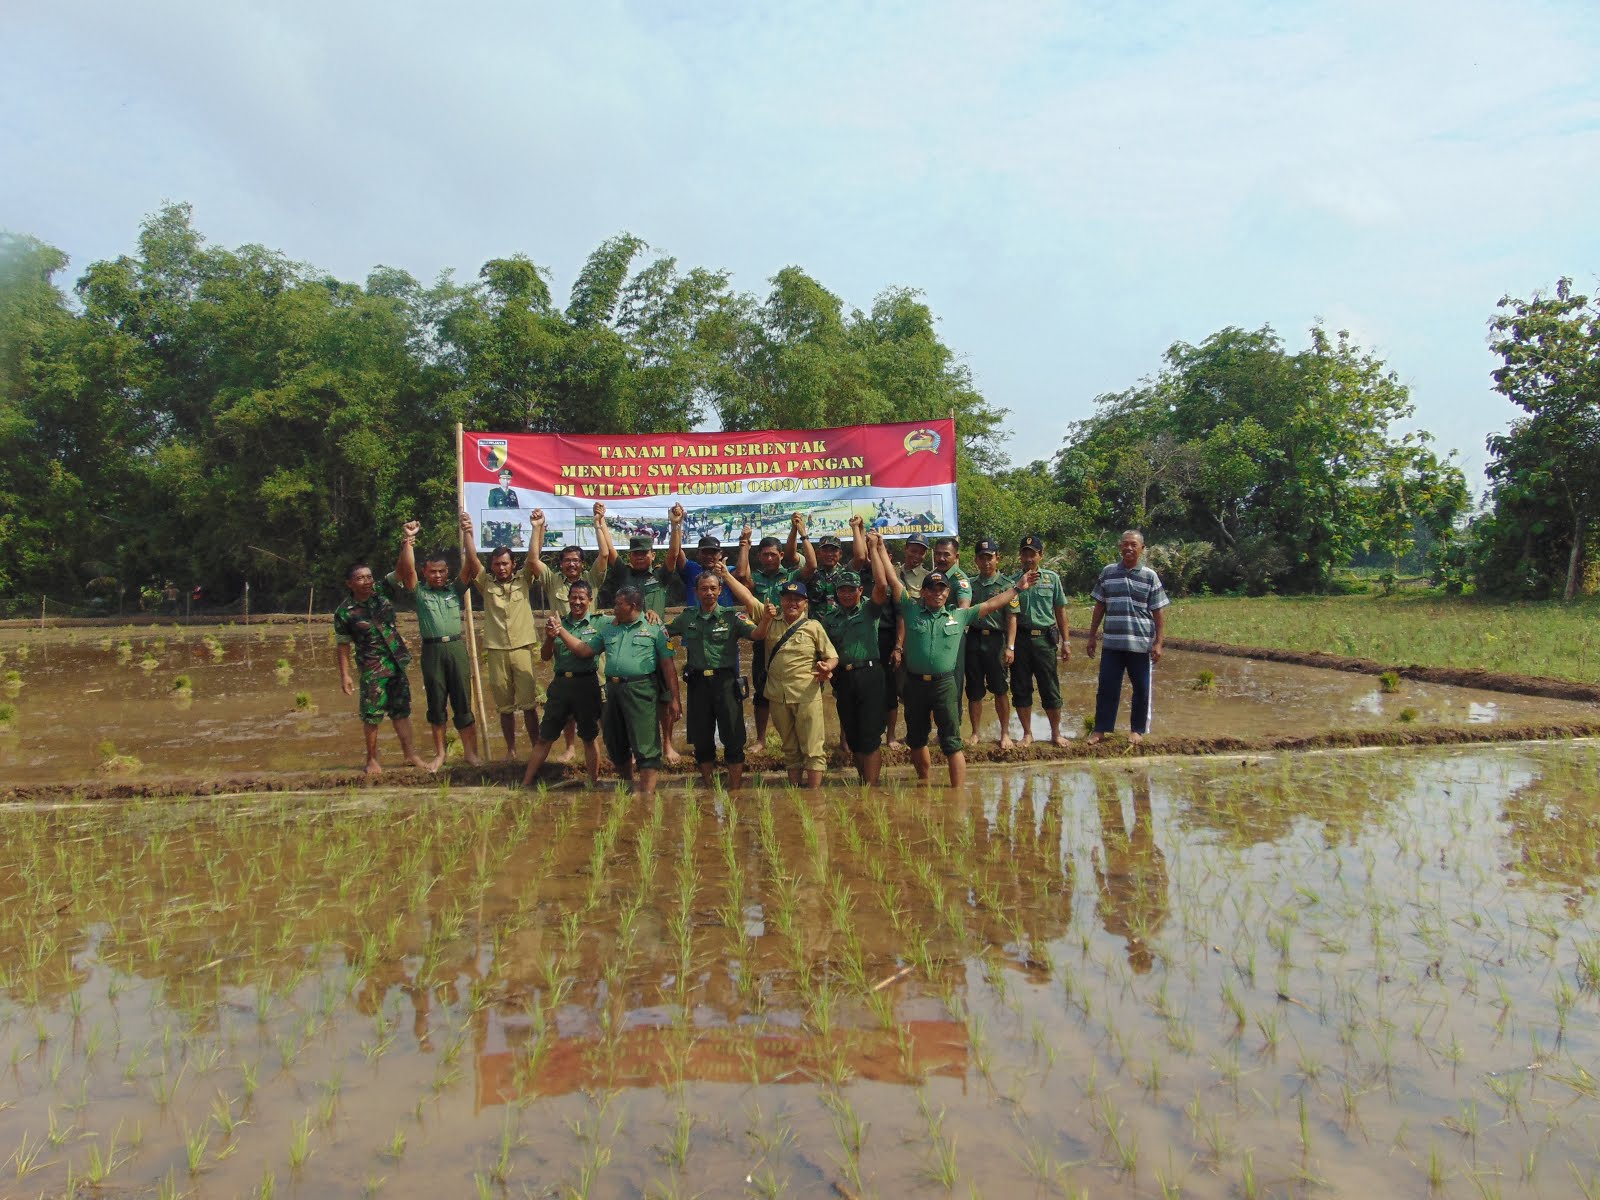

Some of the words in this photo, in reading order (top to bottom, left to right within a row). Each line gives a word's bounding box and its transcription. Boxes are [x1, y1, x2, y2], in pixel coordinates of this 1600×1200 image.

[598, 446, 666, 458] TANAM
[672, 445, 719, 457] PADI
[724, 440, 827, 456] SERENTAK
[561, 465, 642, 477] MENUJU
[648, 461, 782, 477] SWASEMBADA
[787, 456, 864, 472] PANGAN
[554, 484, 575, 496] DI
[582, 482, 671, 496] WILAYAH
[677, 481, 743, 495] KODIM
[747, 474, 872, 493] 0809/KEDIRI
